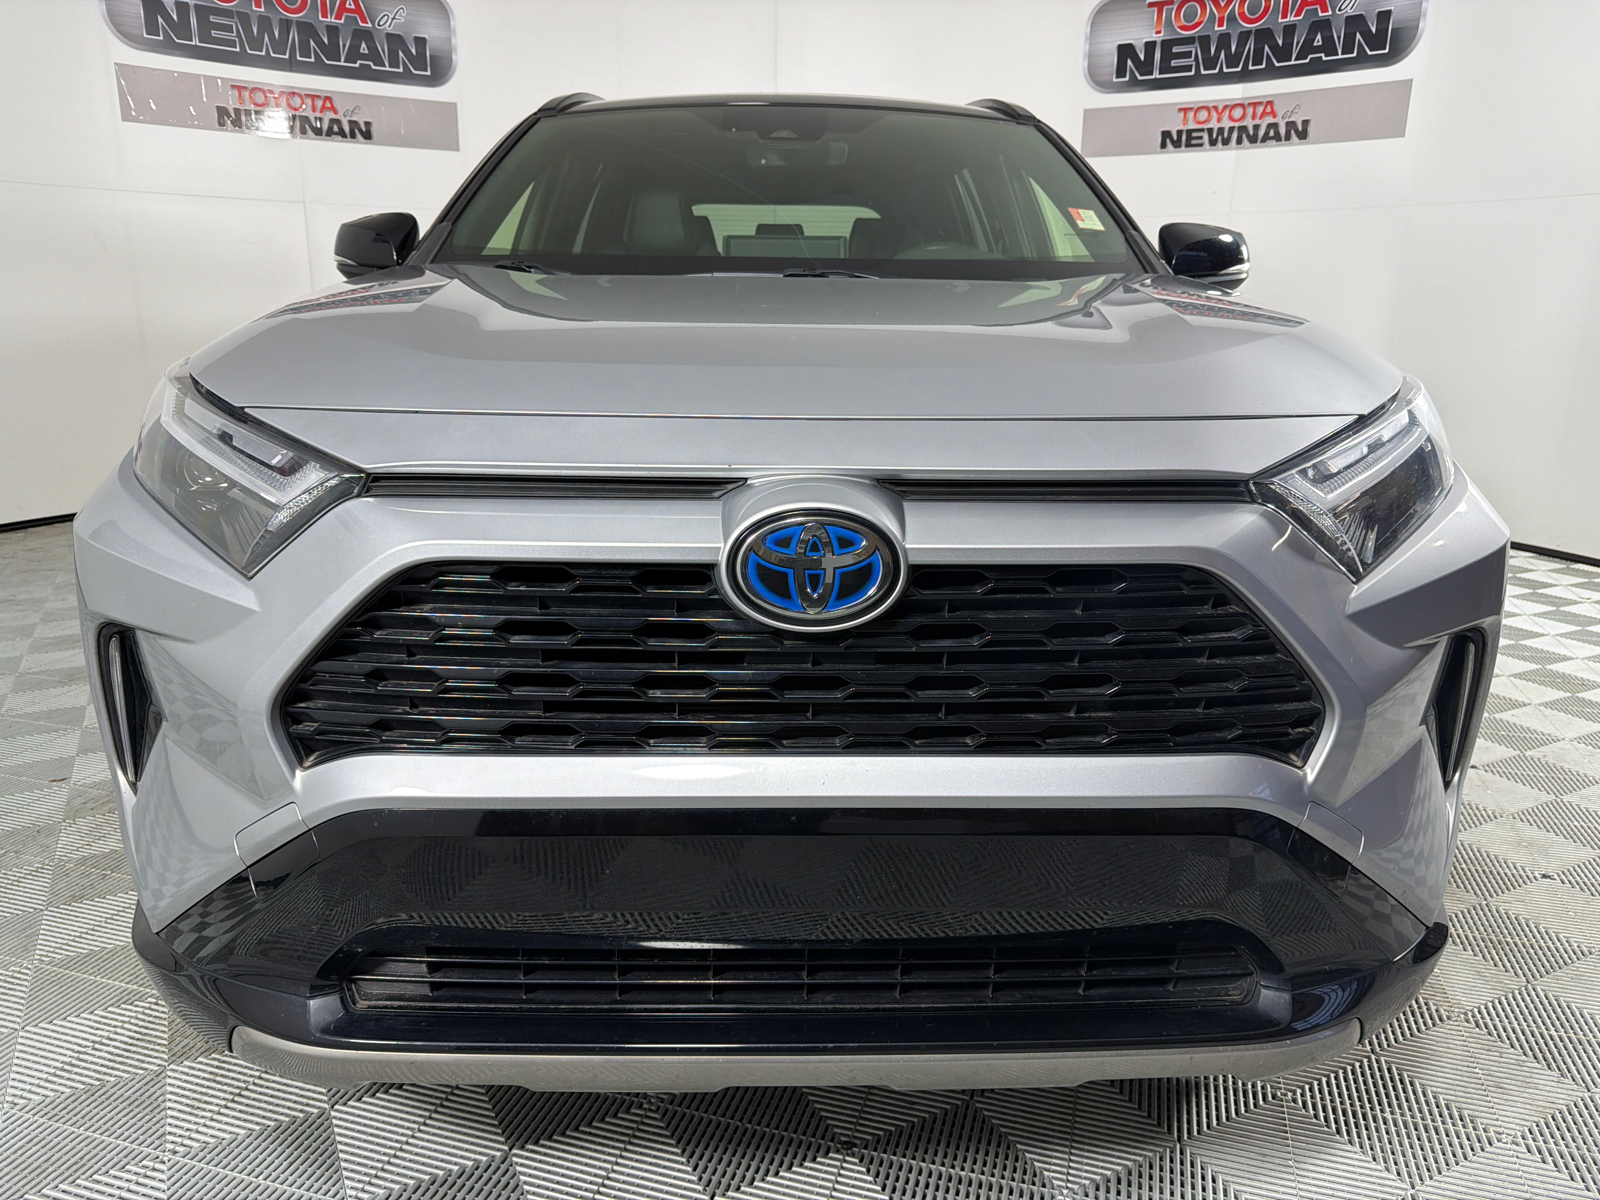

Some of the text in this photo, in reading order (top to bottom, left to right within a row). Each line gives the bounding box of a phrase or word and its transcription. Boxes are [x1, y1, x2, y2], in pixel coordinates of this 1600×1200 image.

[375, 5, 406, 30] of
[140, 0, 431, 75] NEWNAN
[1113, 7, 1394, 82] NEWNAN
[230, 84, 339, 116] TOYOTA
[1178, 100, 1301, 126] TOYOTA of
[1160, 118, 1311, 150] NEWNAN
